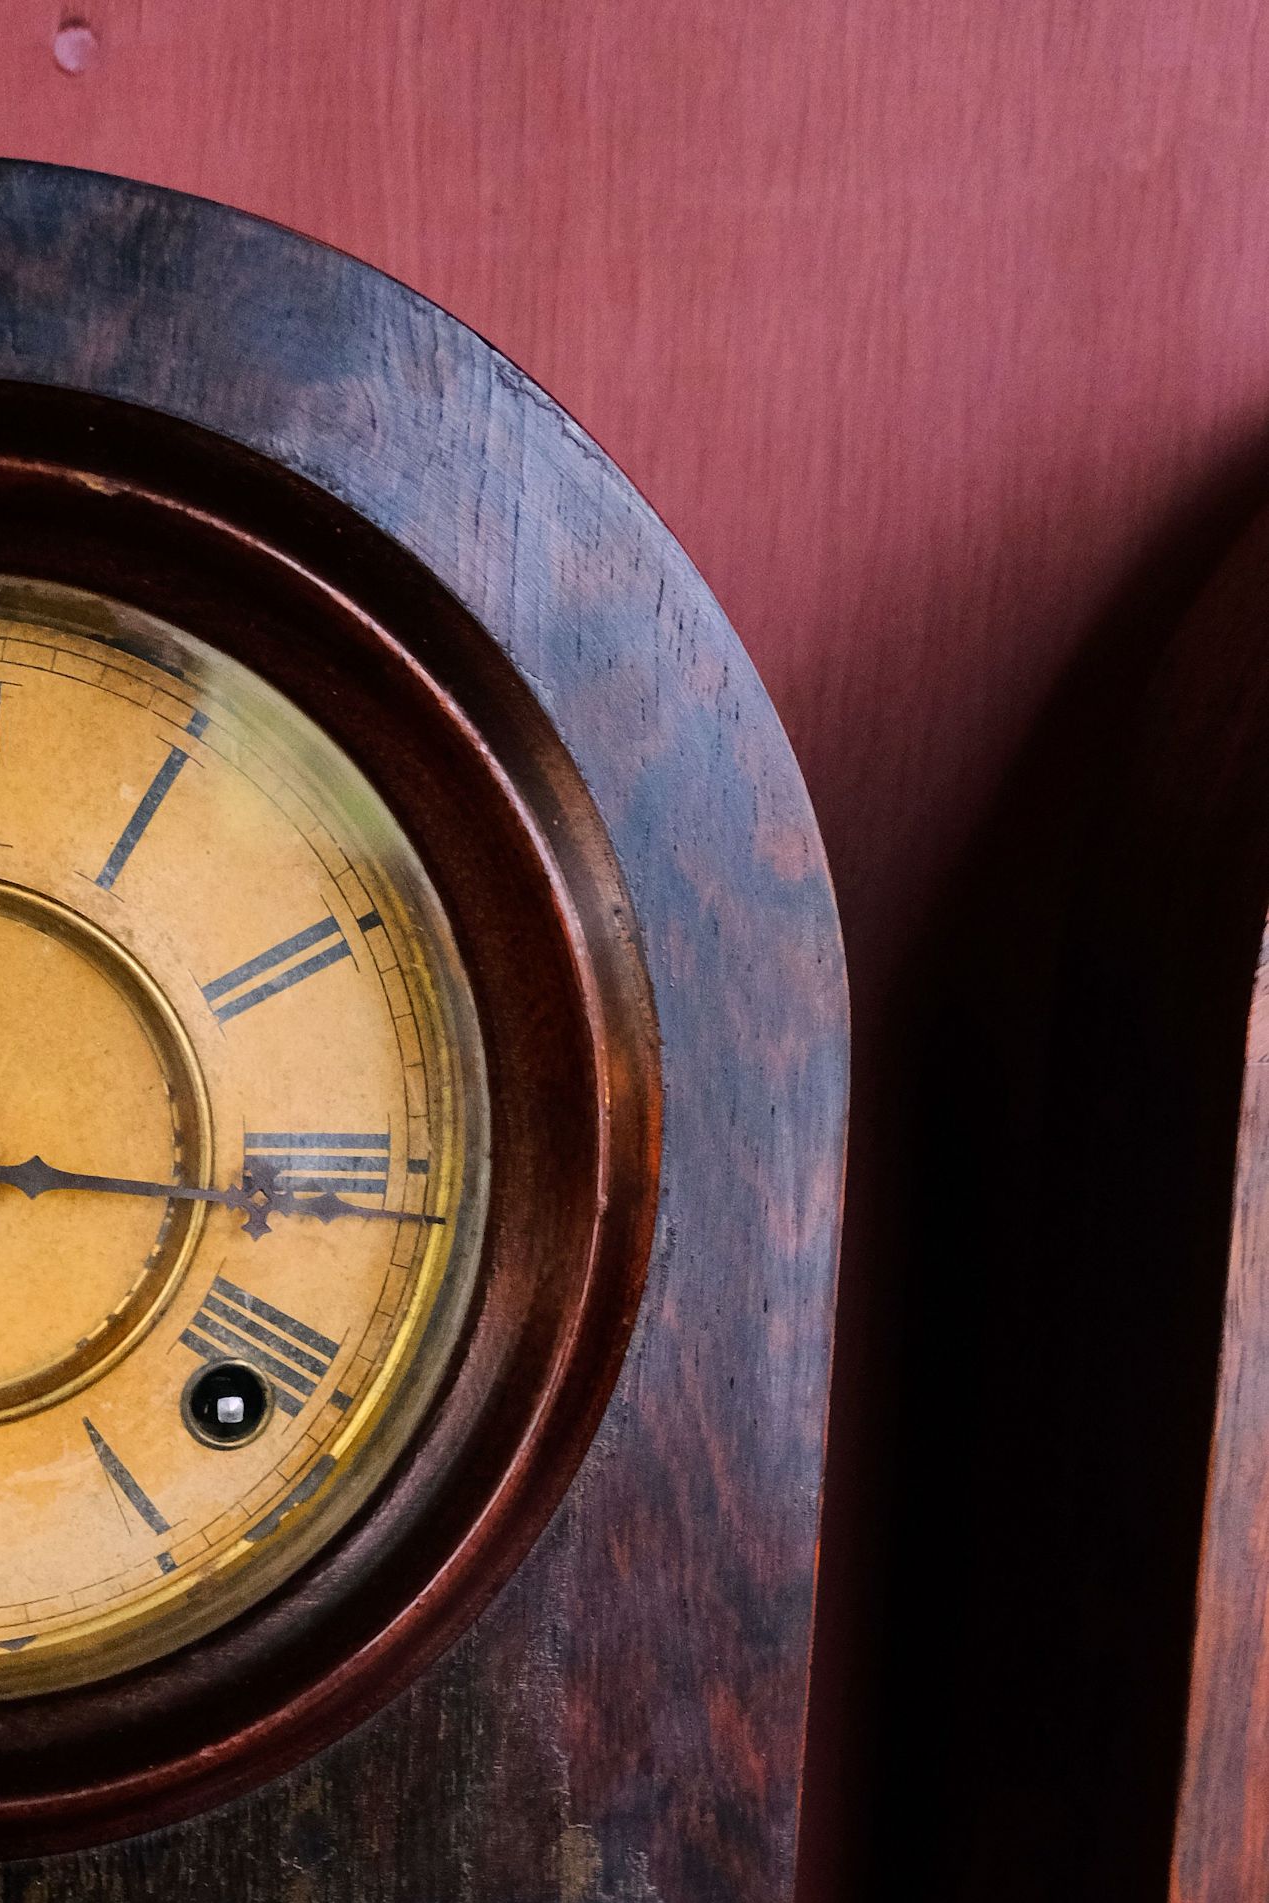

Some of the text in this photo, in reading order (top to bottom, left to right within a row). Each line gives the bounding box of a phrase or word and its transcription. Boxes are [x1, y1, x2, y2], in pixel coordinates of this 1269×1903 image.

[76, 733, 212, 898] I
[193, 895, 359, 1042] II
[243, 1112, 390, 1215] III
[81, 1415, 200, 1539] V
